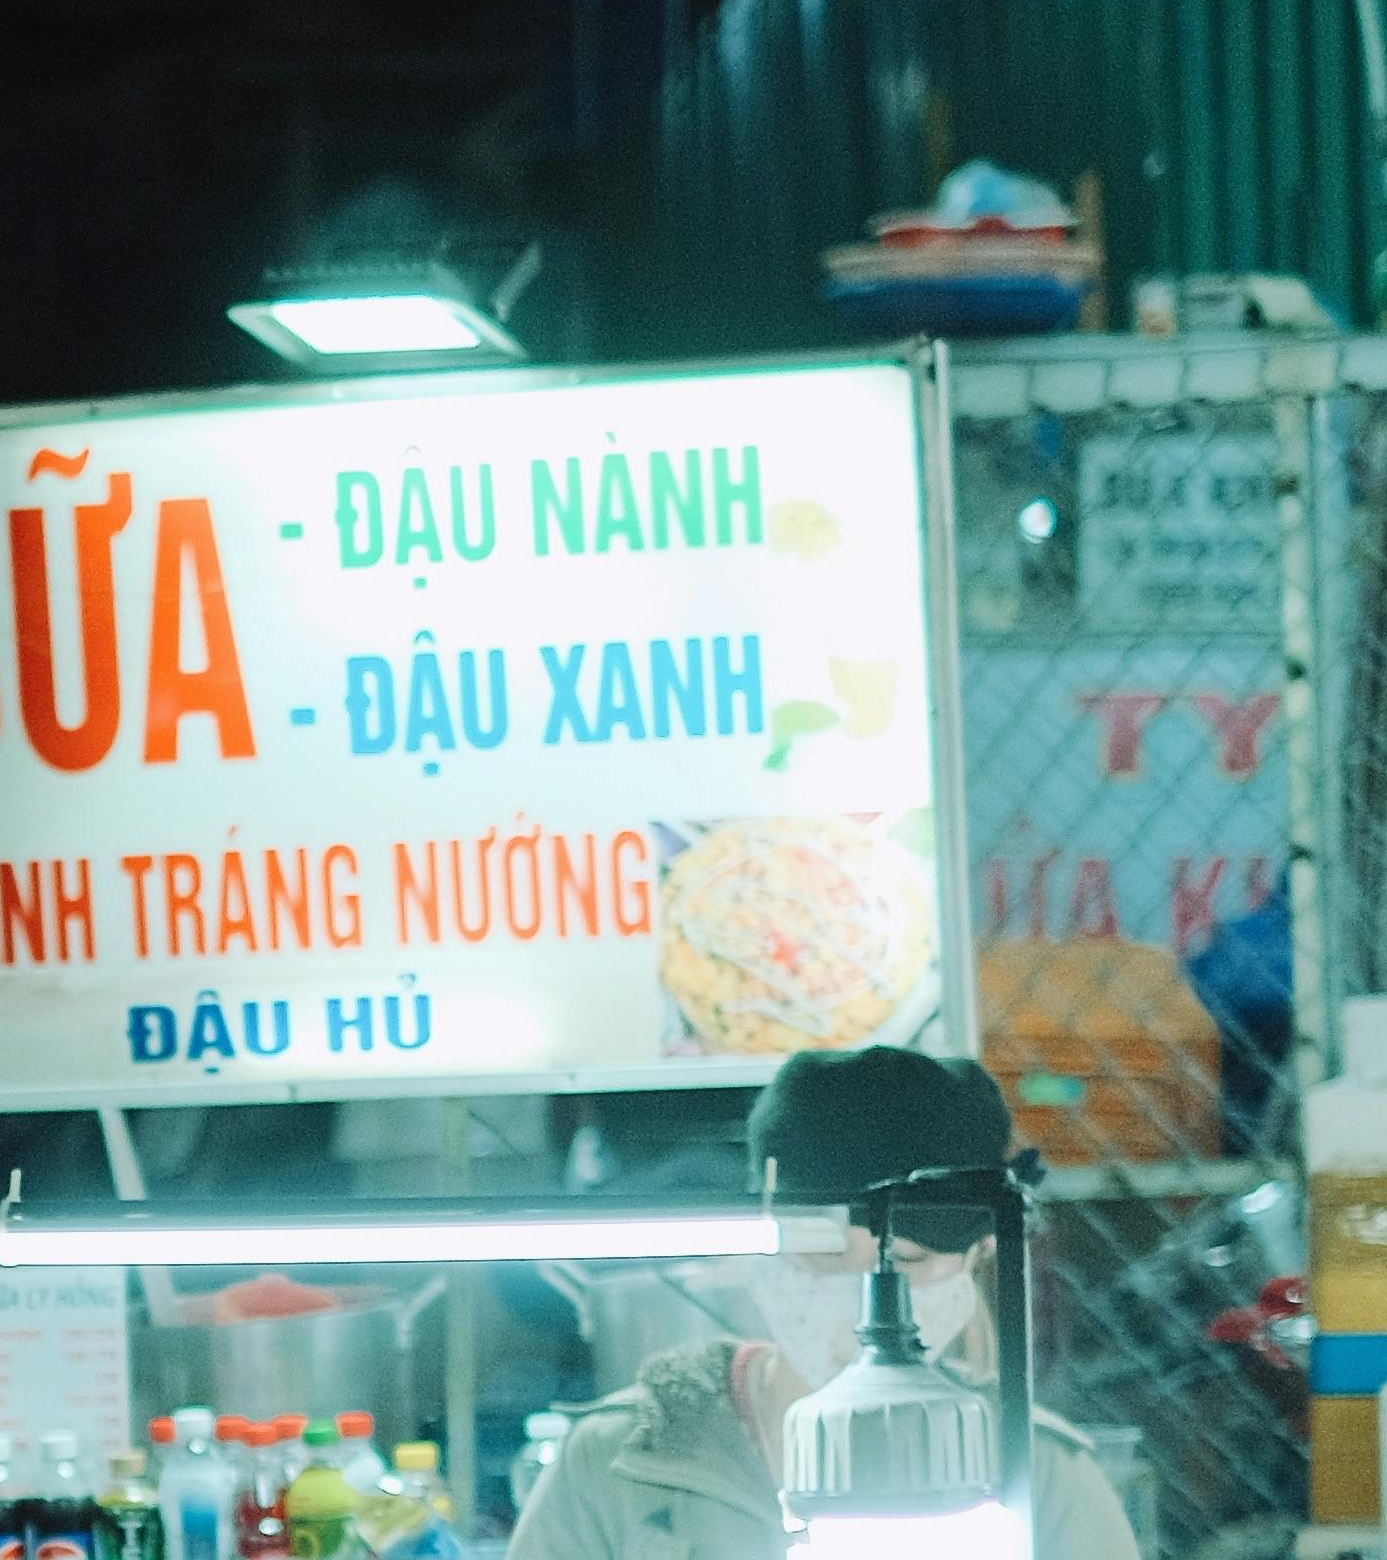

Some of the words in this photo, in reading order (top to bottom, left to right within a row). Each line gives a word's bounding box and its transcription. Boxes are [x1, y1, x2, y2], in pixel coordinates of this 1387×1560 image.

[333, 444, 496, 590] ĐẬU
[529, 430, 764, 557] NÀNH
[344, 629, 508, 777] ĐẬU
[541, 634, 765, 745] XANH
[120, 824, 364, 955] TRÁNG
[391, 810, 654, 947] NƯỚNG
[126, 989, 291, 1075] ĐẬU
[326, 972, 432, 1054] HỦ
